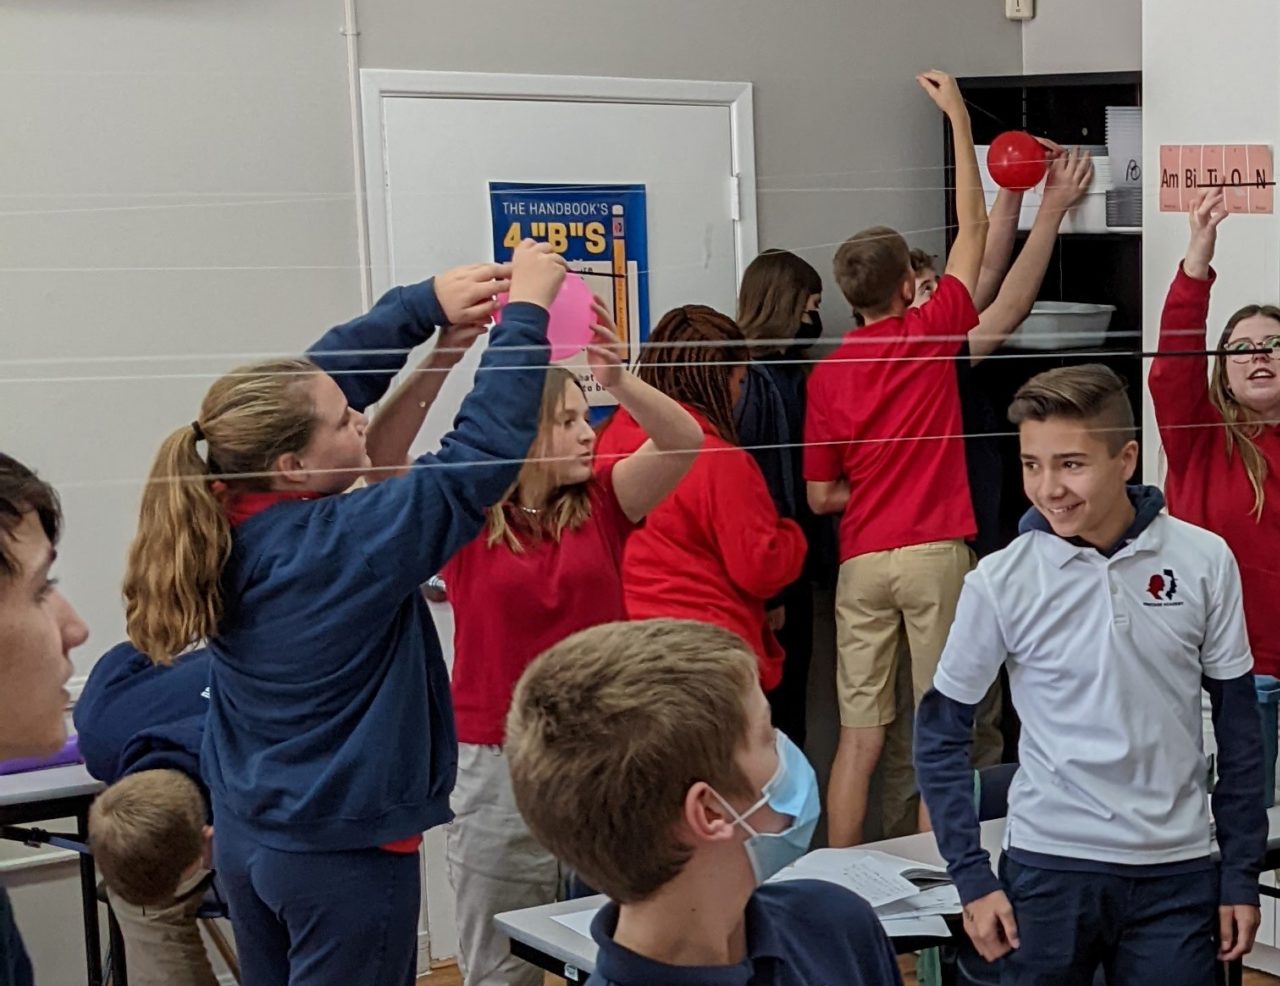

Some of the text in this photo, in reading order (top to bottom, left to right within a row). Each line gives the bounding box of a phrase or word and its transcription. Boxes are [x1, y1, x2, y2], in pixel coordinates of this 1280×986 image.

[1161, 168, 1179, 188] Am
[503, 202, 609, 216] THE HANDBOOK'S
